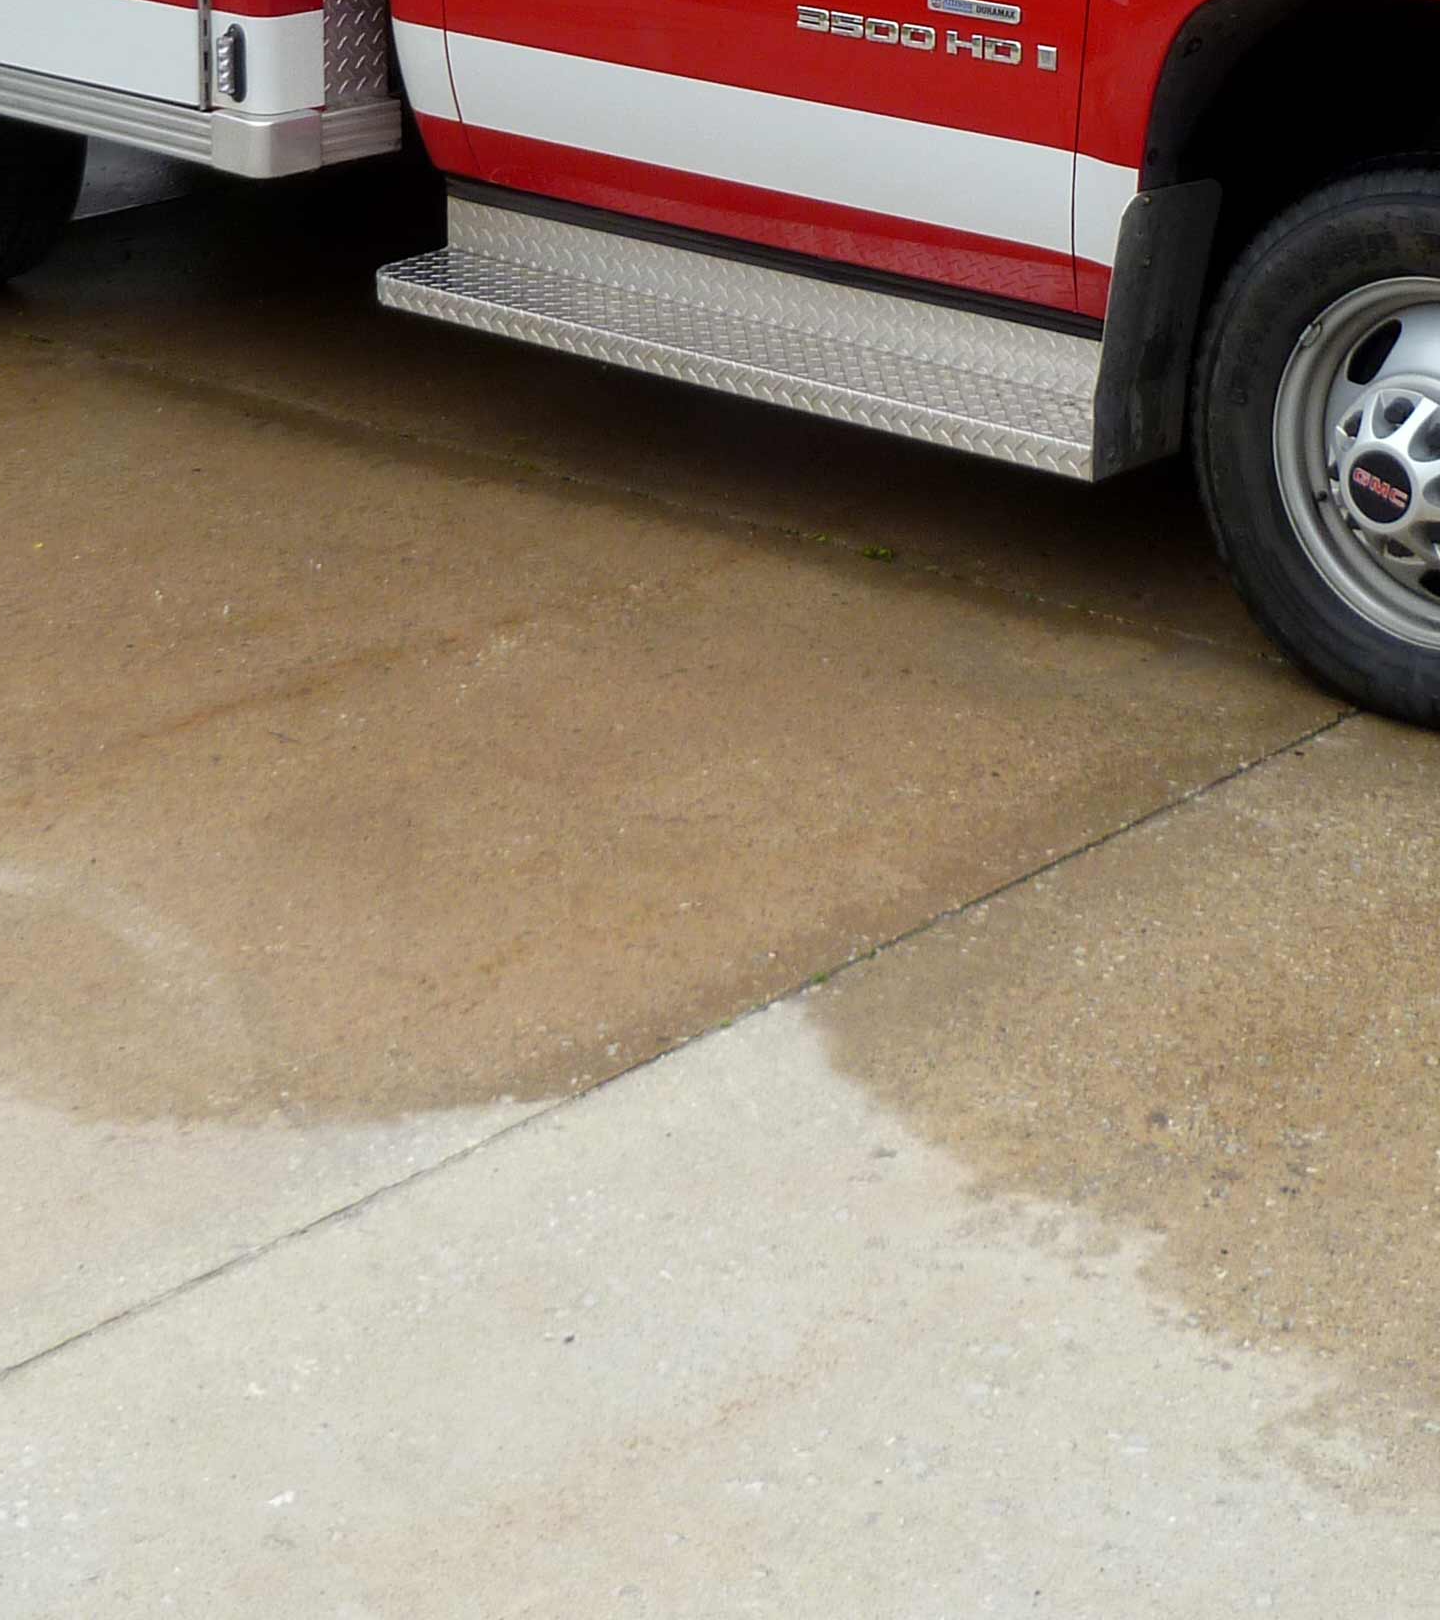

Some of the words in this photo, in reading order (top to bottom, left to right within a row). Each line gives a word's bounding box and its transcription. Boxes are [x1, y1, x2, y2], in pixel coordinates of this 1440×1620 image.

[796, 5, 936, 51] 3500
[946, 30, 1022, 65] HD
[1352, 467, 1408, 508] GMC
